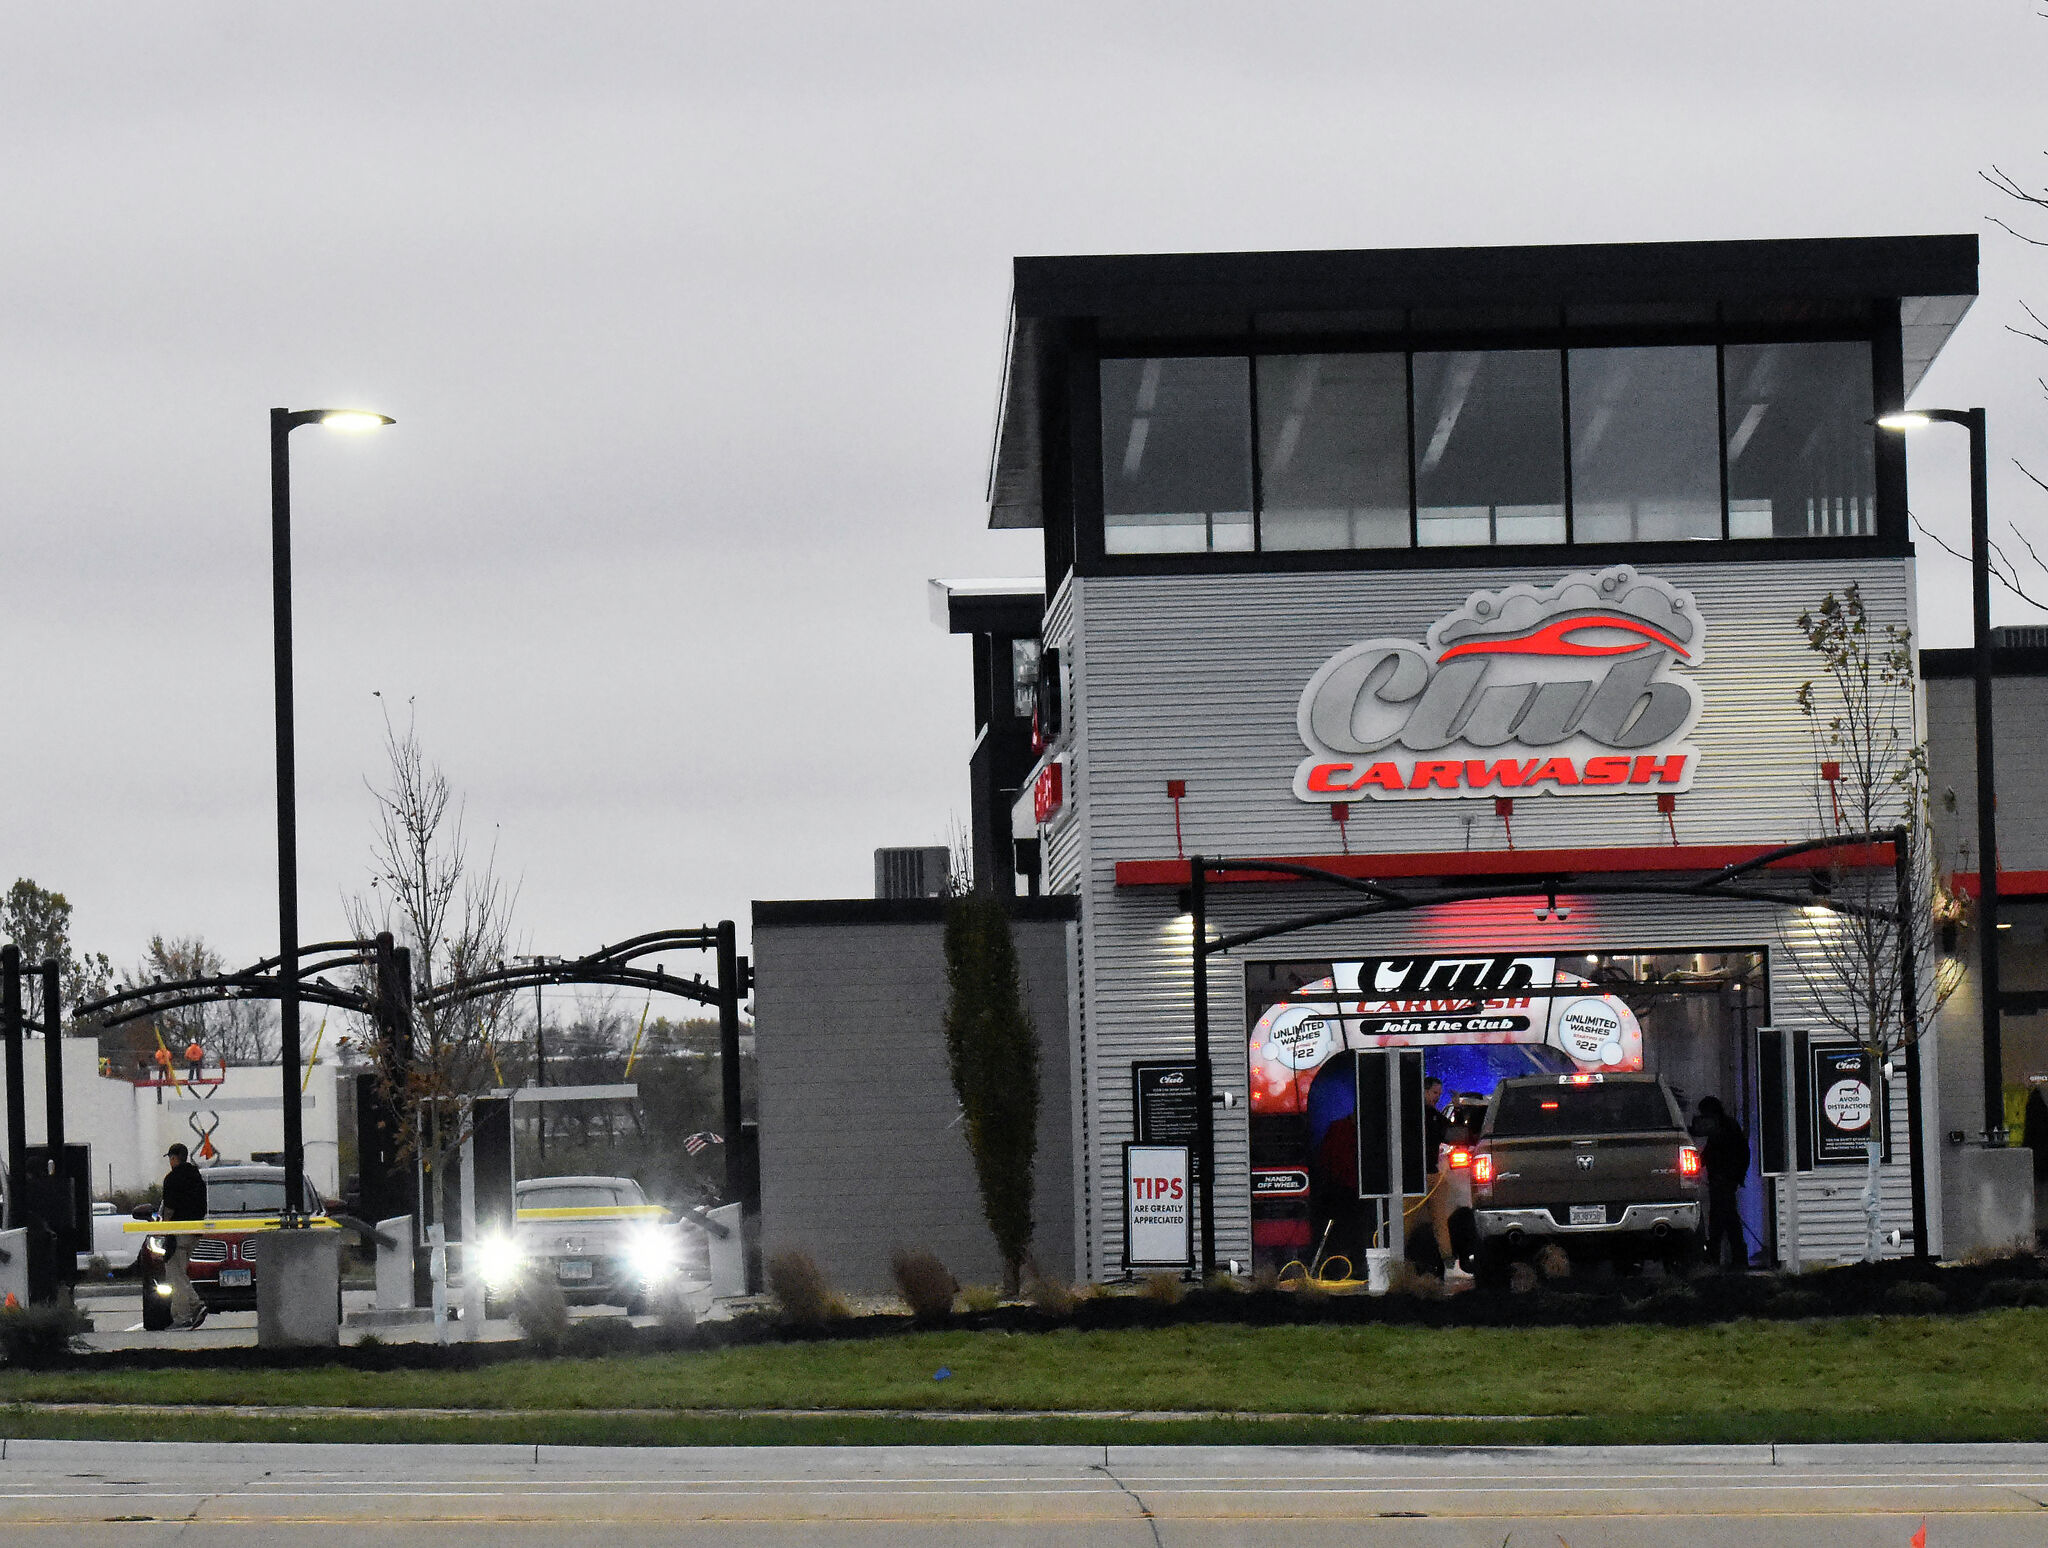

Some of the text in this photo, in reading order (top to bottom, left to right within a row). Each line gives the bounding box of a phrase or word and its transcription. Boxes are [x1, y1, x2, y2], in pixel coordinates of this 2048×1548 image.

[1311, 648, 1692, 753] Club
[1307, 754, 1687, 792] CARWASH
[1375, 1018, 1514, 1033] Join the Club
[1565, 1014, 1617, 1029] UNLIMITED
[1273, 1021, 1324, 1039] UNLIMITED
[1570, 1024, 1611, 1036] WASHES
[1281, 1031, 1320, 1046] WASHES
[1576, 1040, 1598, 1052] $22
[1265, 1175, 1292, 1183] HANDS
[1273, 1181, 1300, 1189] WHEEL
[1133, 1177, 1183, 1199] TIPS
[1134, 1204, 1183, 1212] ARE GREATLY
[1134, 1216, 1184, 1224] APPRECIATED
